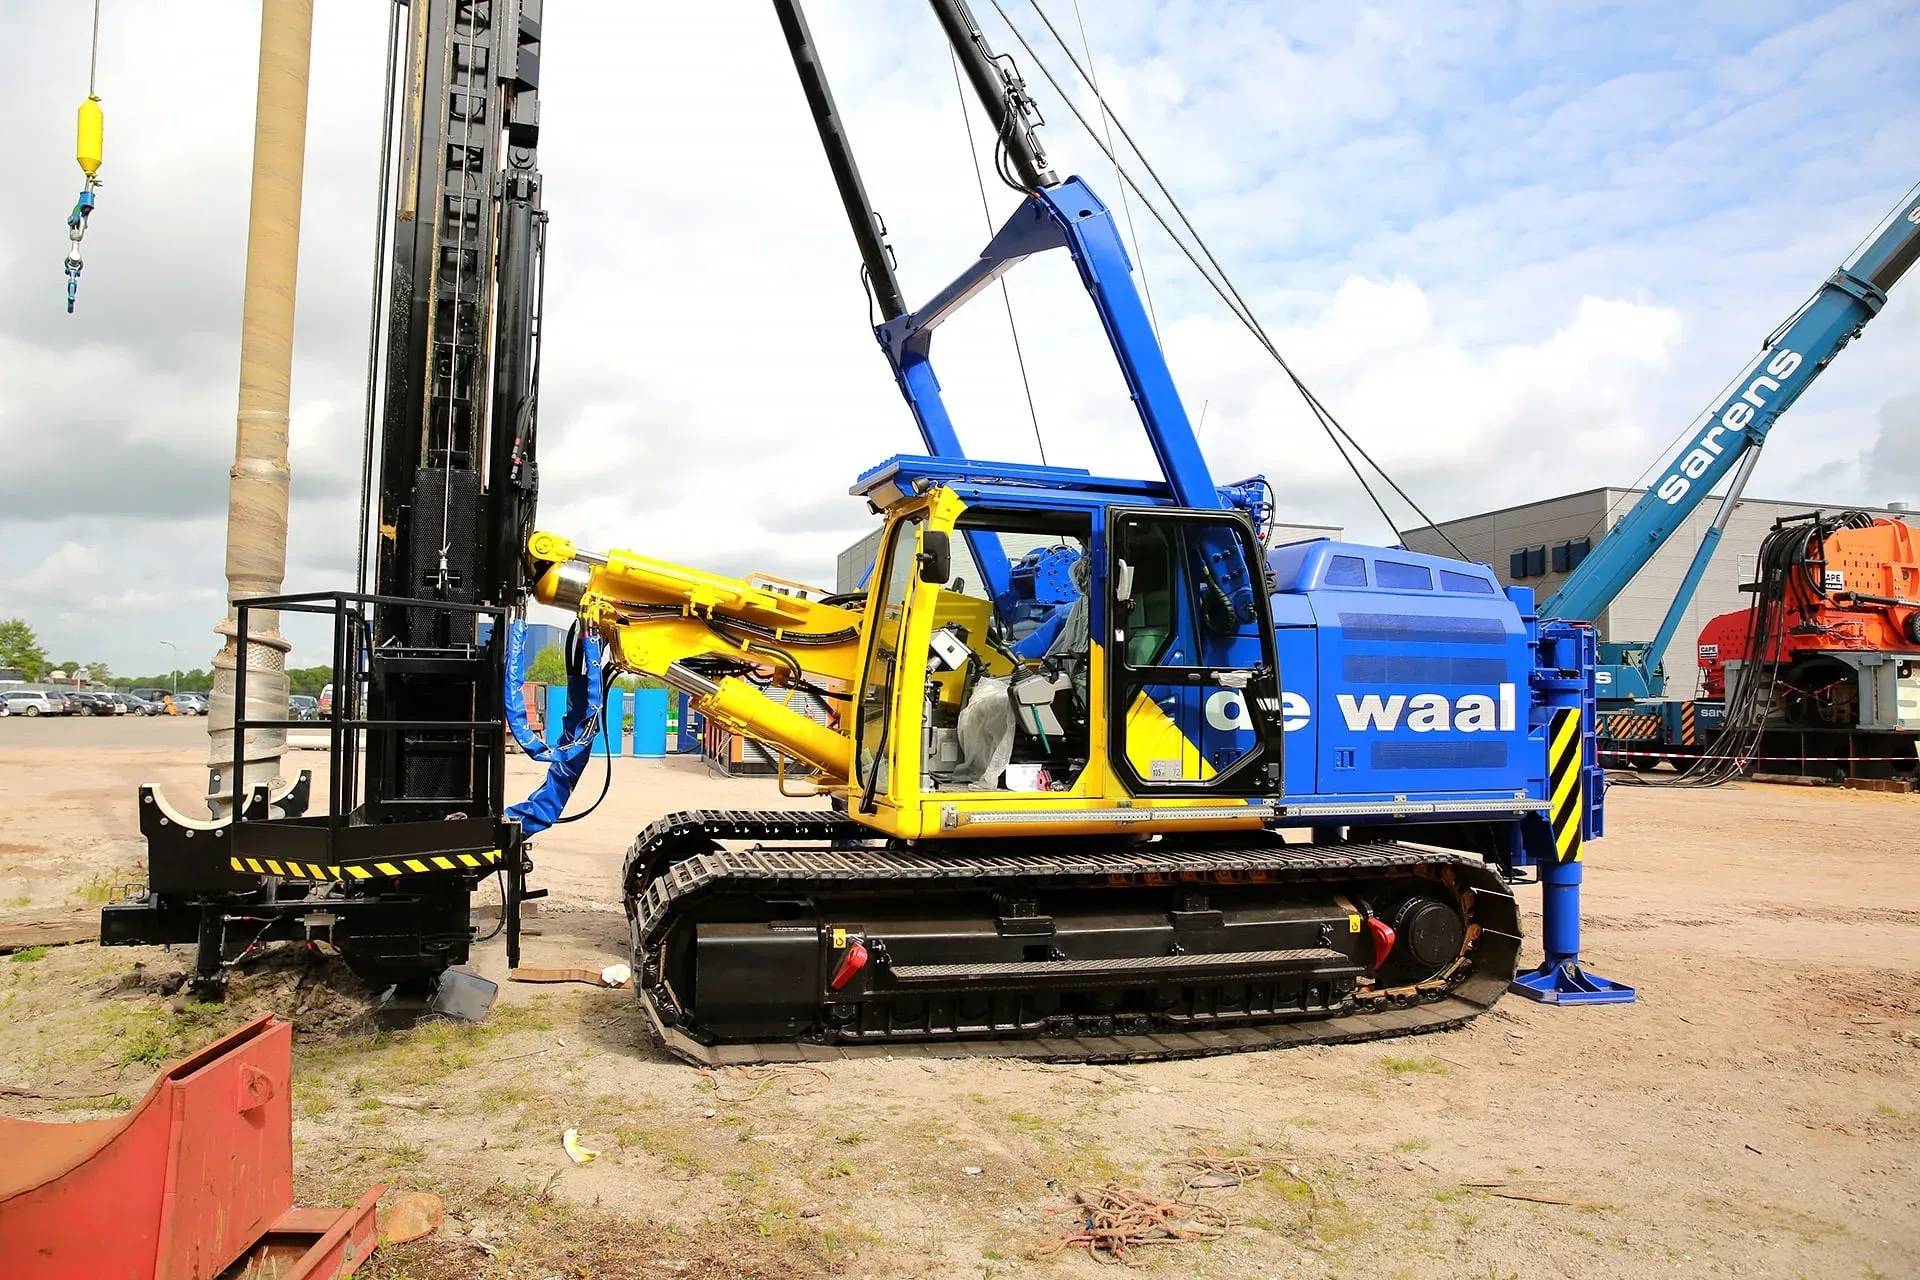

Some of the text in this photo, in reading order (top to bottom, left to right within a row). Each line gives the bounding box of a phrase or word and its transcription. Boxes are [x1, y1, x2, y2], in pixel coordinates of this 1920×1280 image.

[1657, 348, 1803, 505] sarens
[1825, 573, 1841, 582] APE
[1336, 683, 1516, 732] waal
